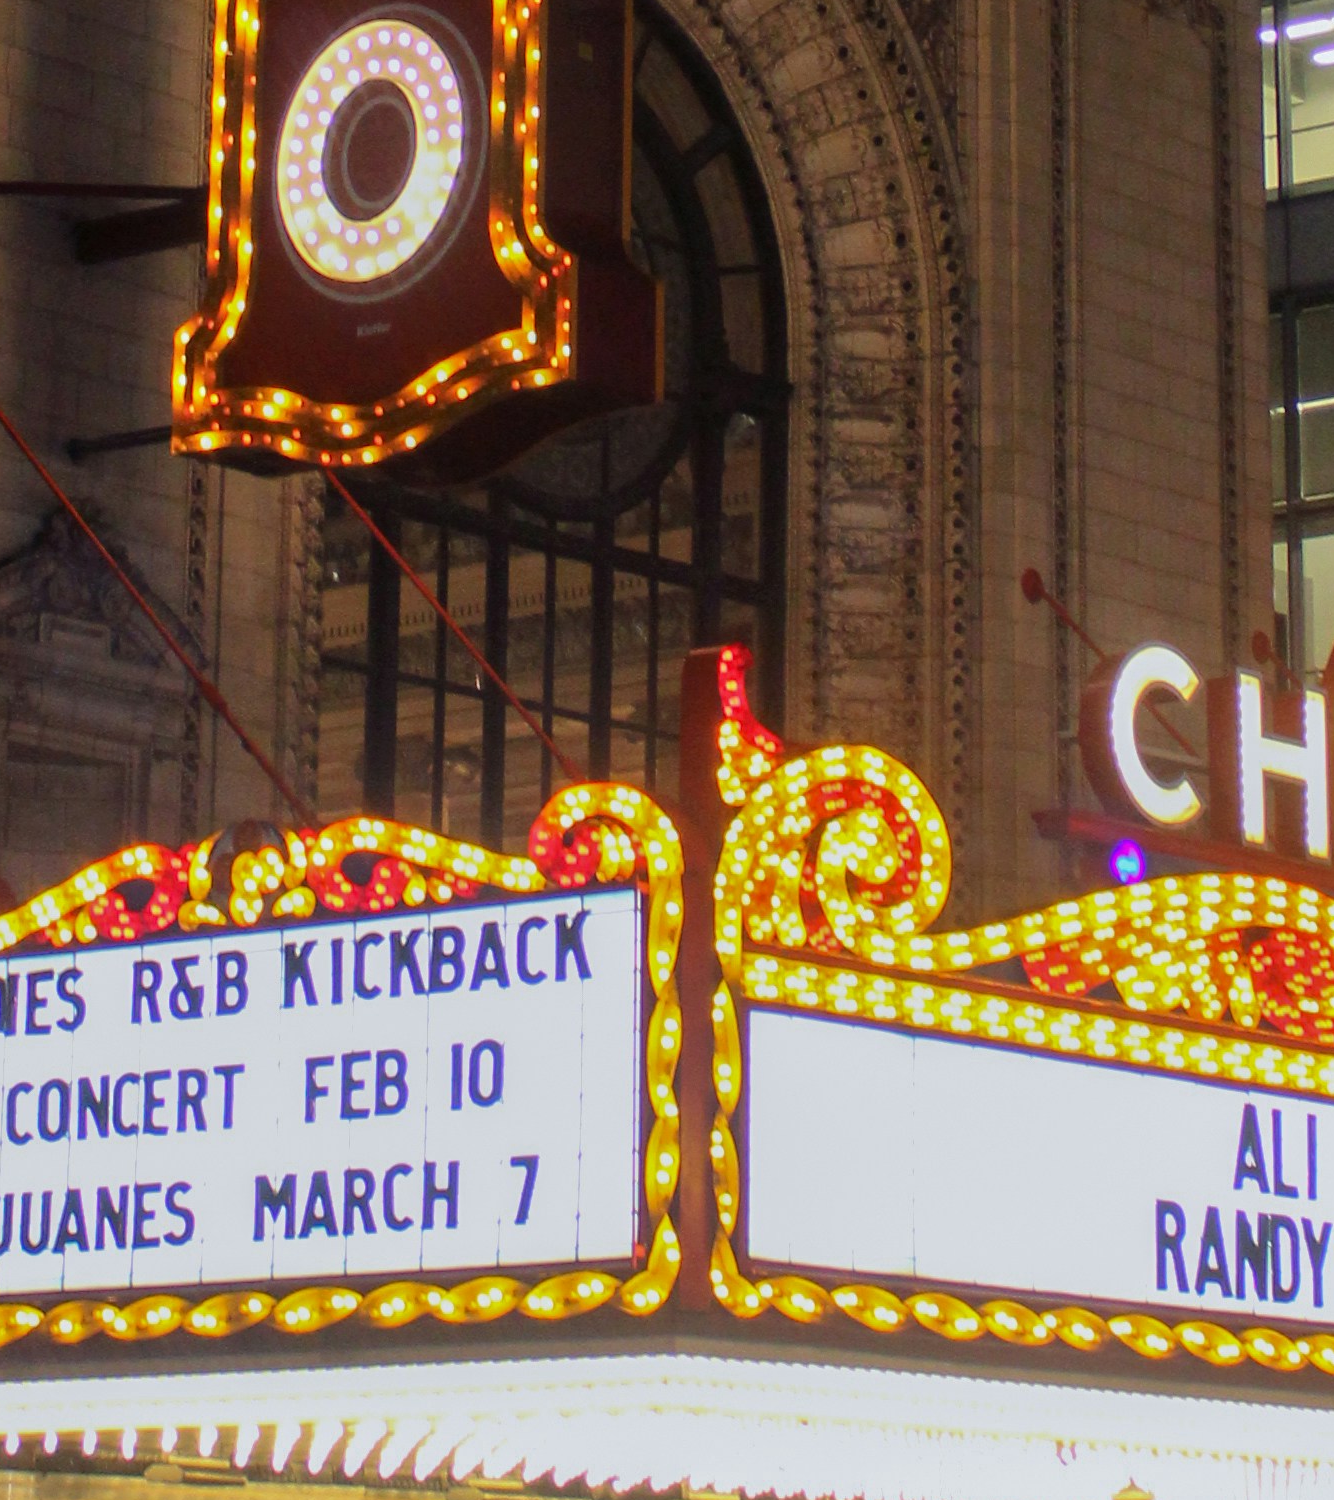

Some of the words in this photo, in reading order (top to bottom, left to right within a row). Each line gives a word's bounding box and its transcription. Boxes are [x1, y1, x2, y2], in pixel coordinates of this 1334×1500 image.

[130, 950, 250, 1025] R&B
[281, 909, 594, 1009] KICKBACK
[5, 1064, 245, 1146] CONCERT
[303, 1048, 408, 1123] FEB
[450, 1038, 504, 1111] 10
[252, 1160, 460, 1243] MARCH
[509, 1154, 540, 1227] 7
[1233, 1102, 1319, 1201] ALI
[1153, 1198, 1332, 1310] RANDY
